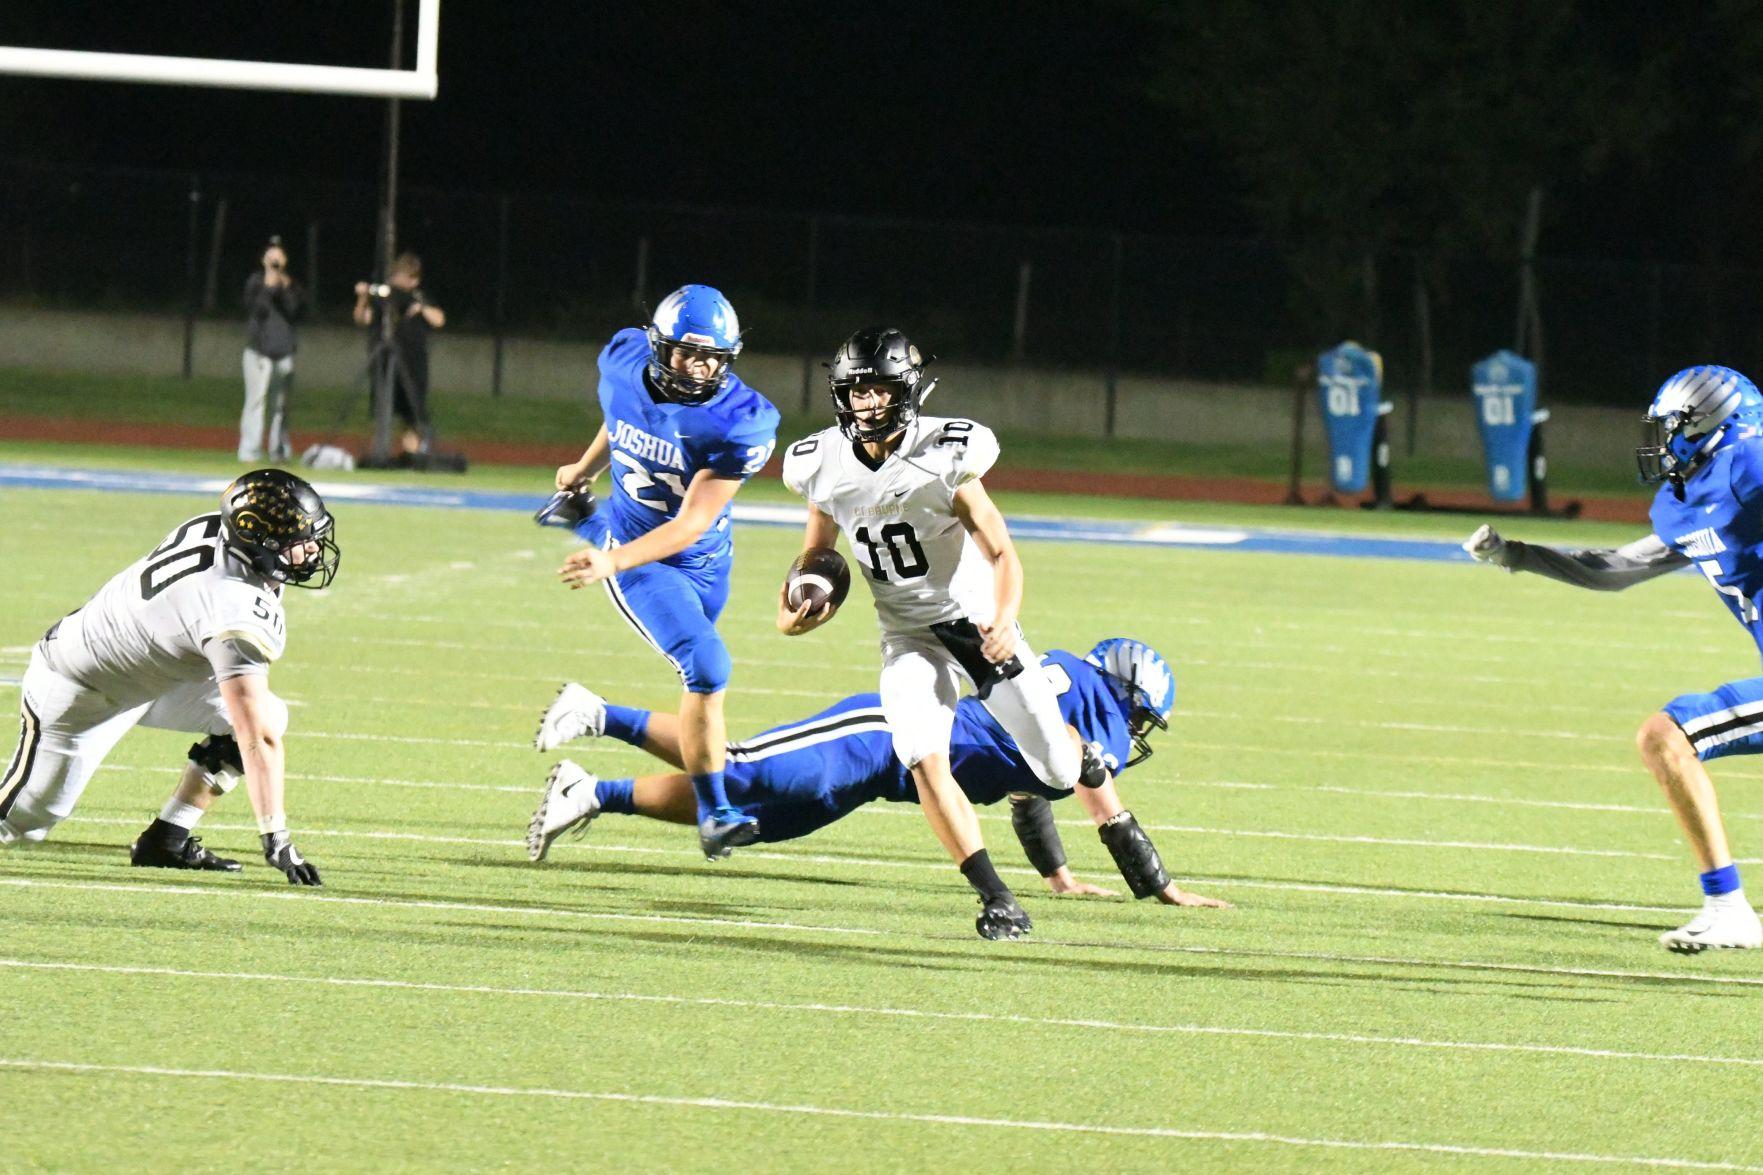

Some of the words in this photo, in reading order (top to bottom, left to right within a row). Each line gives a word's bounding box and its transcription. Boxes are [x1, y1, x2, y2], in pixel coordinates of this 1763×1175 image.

[608, 419, 685, 471] JOSHUA
[939, 421, 974, 447] 10
[855, 521, 930, 581] 10
